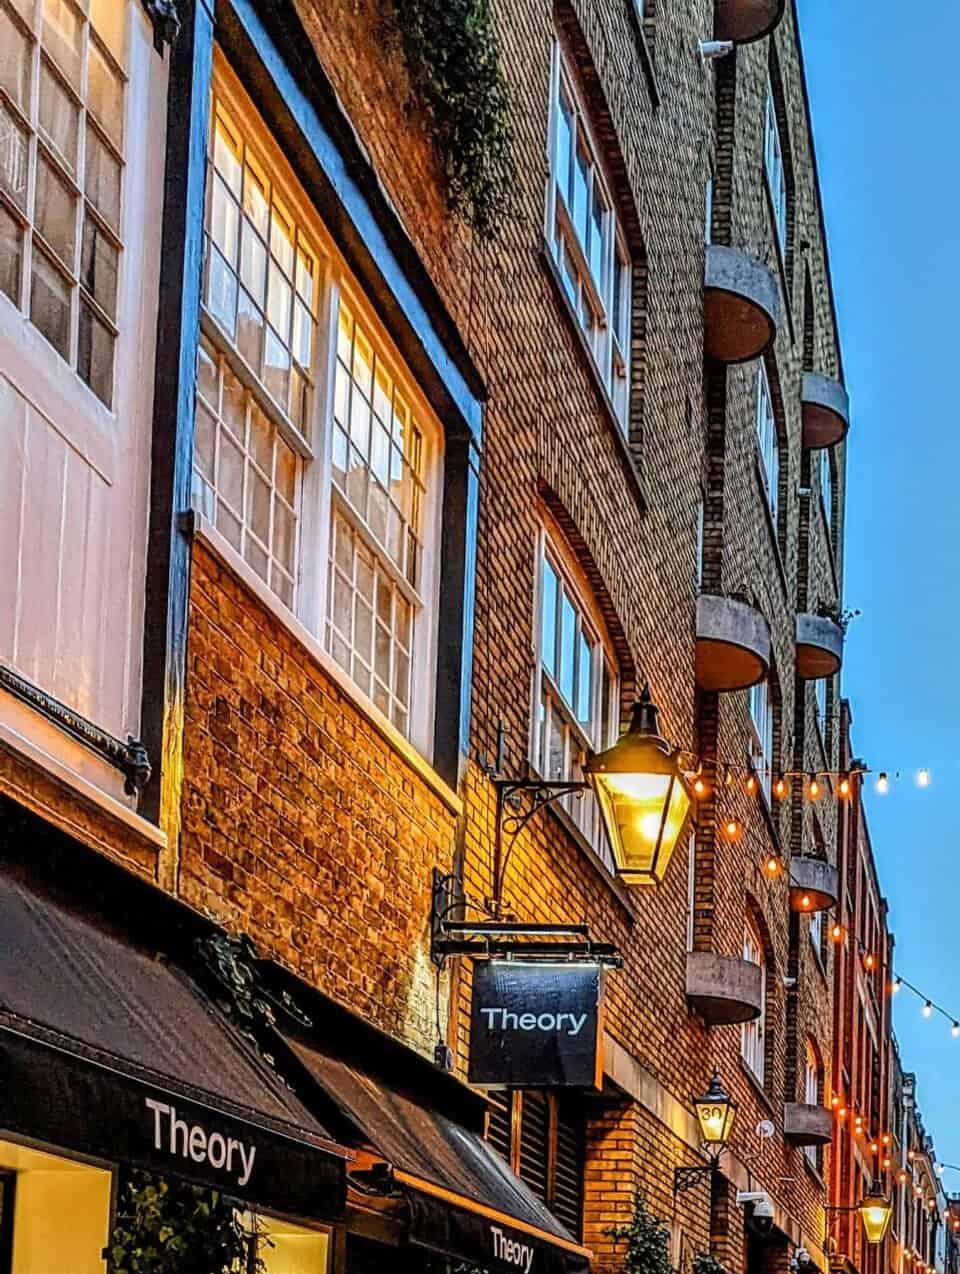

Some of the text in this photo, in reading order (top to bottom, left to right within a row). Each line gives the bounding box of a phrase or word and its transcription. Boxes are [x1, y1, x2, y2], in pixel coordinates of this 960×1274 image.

[480, 1007, 588, 1035] Theory
[145, 1097, 257, 1186] Theory
[490, 1225, 535, 1274] Theory
